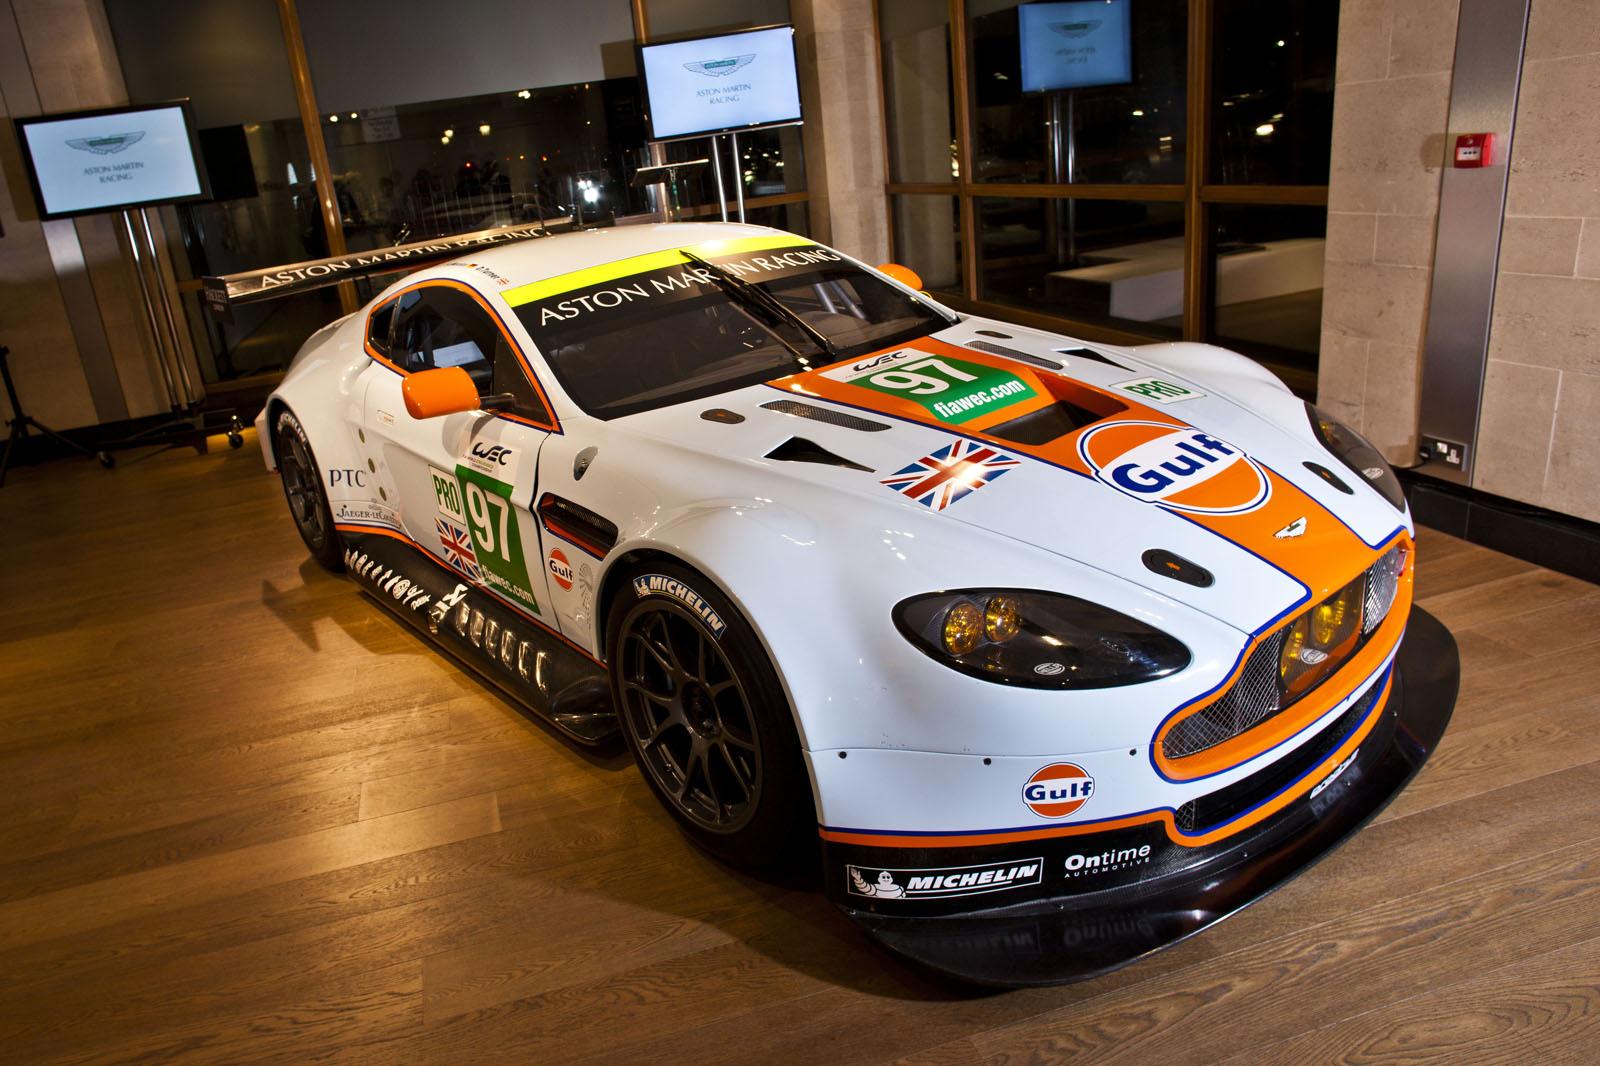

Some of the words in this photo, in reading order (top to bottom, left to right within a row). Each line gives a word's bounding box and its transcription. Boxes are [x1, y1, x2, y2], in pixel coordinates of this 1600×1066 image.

[695, 88, 721, 97] ASTON
[723, 83, 751, 93] MARTIN
[709, 95, 740, 105] RACING
[84, 166, 111, 175] ASTON
[112, 162, 144, 171] MARTIN
[99, 173, 133, 183] RACING
[260, 260, 351, 289] ASTON
[356, 243, 452, 265] MARTIN
[540, 283, 650, 326] ASTON
[649, 260, 760, 293] MARIN
[751, 249, 841, 272] RACING
[853, 351, 908, 373] WEC
[869, 358, 979, 395] 97
[933, 378, 1026, 418] fiawec.com
[1122, 380, 1191, 400] PRO
[471, 441, 513, 466] WEC
[1111, 433, 1235, 494] Gulf
[328, 469, 367, 488] PTC
[432, 474, 461, 514] PRO
[336, 504, 401, 529] JAEGER-LEC
[465, 482, 511, 562] 97
[549, 558, 573, 583] Gulf
[649, 576, 723, 632] MICHELIN
[1024, 780, 1094, 800] Gulf
[1064, 844, 1151, 871] Ontime
[1064, 857, 1151, 879] AUTOMOTIVE
[906, 863, 1039, 891] MICHELIN
